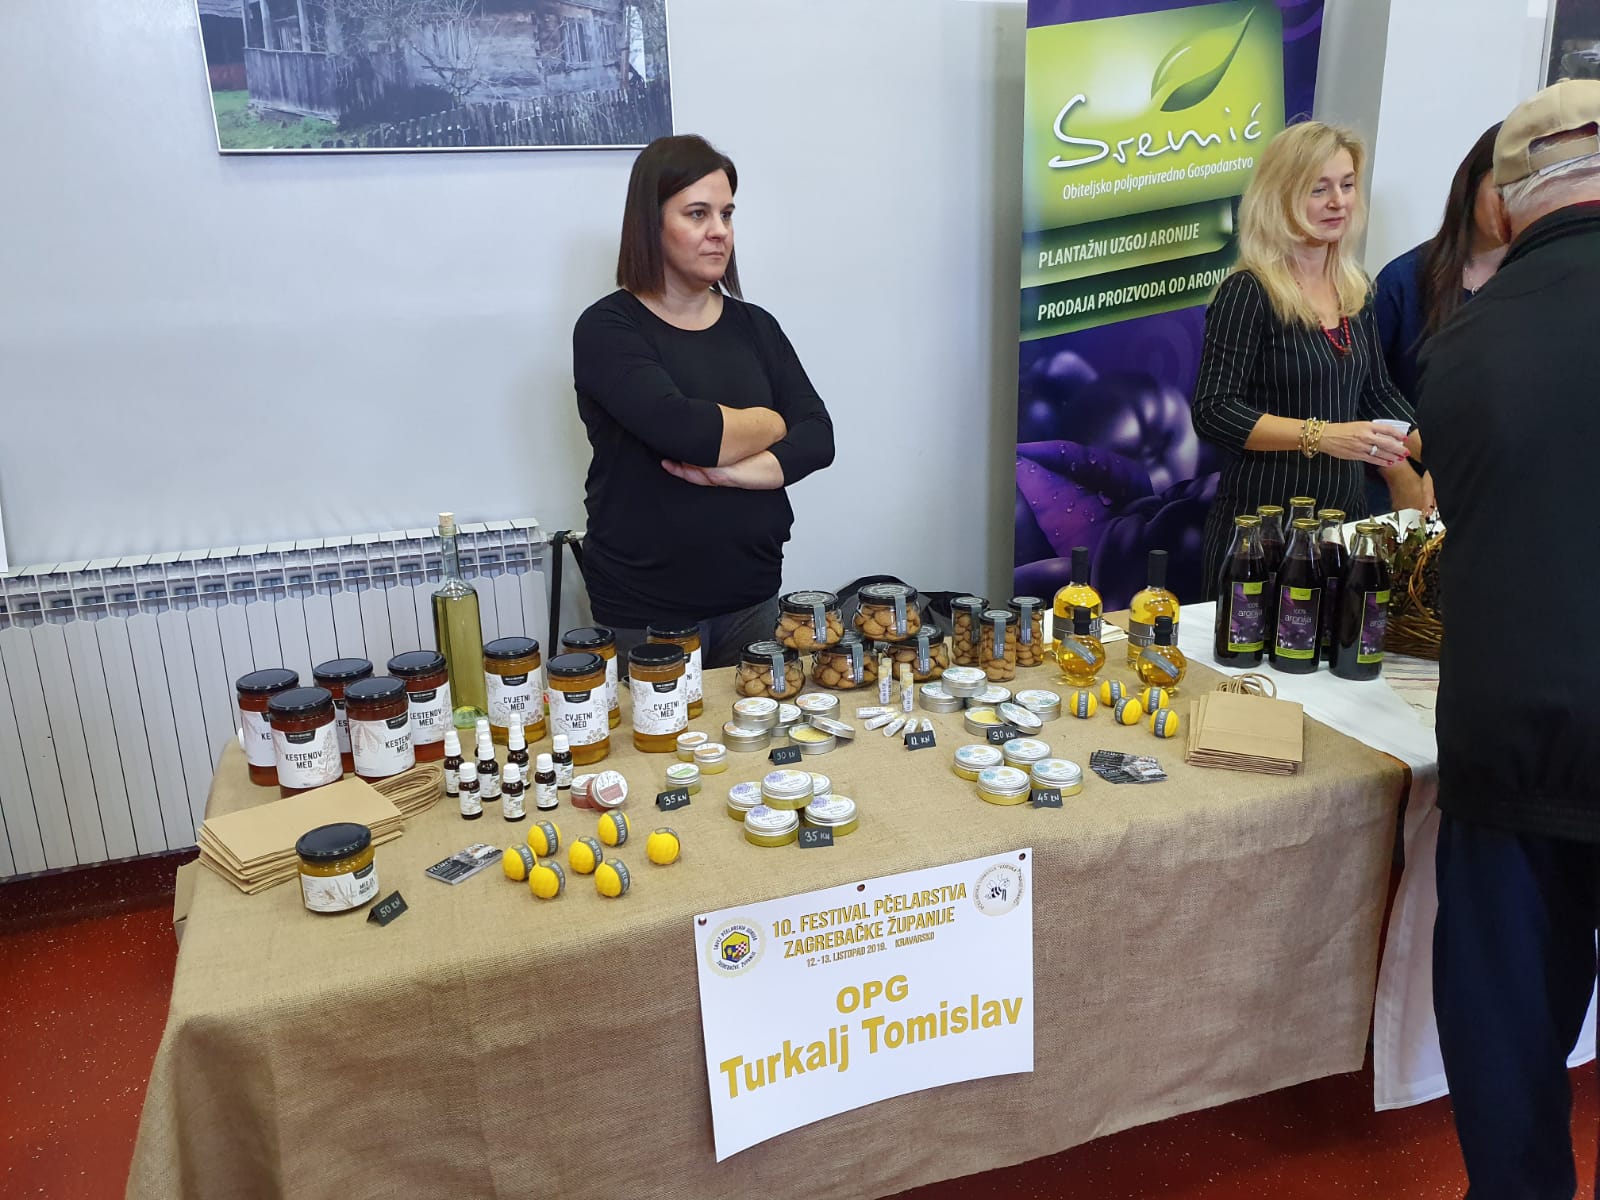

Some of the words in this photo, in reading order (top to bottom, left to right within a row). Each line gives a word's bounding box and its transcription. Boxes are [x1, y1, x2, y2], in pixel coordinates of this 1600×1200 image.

[1048, 94, 1262, 168] Sremić
[1063, 179, 1112, 200] Obiteljsko
[1114, 168, 1185, 195] poljoprivredno
[1187, 156, 1254, 179] Gospodarstvo
[1038, 239, 1107, 269] PLANTAŽNI
[1110, 232, 1149, 255] UZGOJ
[1149, 223, 1200, 247] ARONIJE
[1037, 294, 1096, 321] PRODAJA
[1097, 279, 1166, 309] PROIZVODA
[1168, 276, 1186, 294] OD
[1284, 614, 1312, 624] aronija
[503, 694, 531, 704] CVJETNI
[510, 703, 525, 711] MED
[653, 700, 680, 711] CVJETNI
[565, 711, 593, 722] CVJETNI
[660, 710, 675, 718] MED
[418, 719, 434, 727] MED
[572, 720, 587, 728] MED
[992, 731, 1004, 740] 30
[396, 744, 409, 754] MED
[285, 750, 323, 762] KESTENOV
[296, 760, 313, 769] MED
[663, 795, 676, 806] 35
[1037, 792, 1048, 803] 45
[804, 832, 818, 842] 35
[380, 904, 391, 917] 50
[772, 918, 796, 938] 10.
[799, 902, 870, 933] FESTIVAL
[873, 882, 967, 917] PČELARSTVA
[783, 922, 884, 959] ZAGREBAČKE
[886, 906, 956, 937] ŽUPANIJE
[833, 947, 866, 962] LISTOPAD
[867, 942, 887, 954] 2019.
[894, 931, 935, 948] KRAVARSKO
[836, 974, 909, 1014] OPG
[720, 1024, 849, 1100] Turkalj
[861, 994, 1023, 1055] Tomislav
